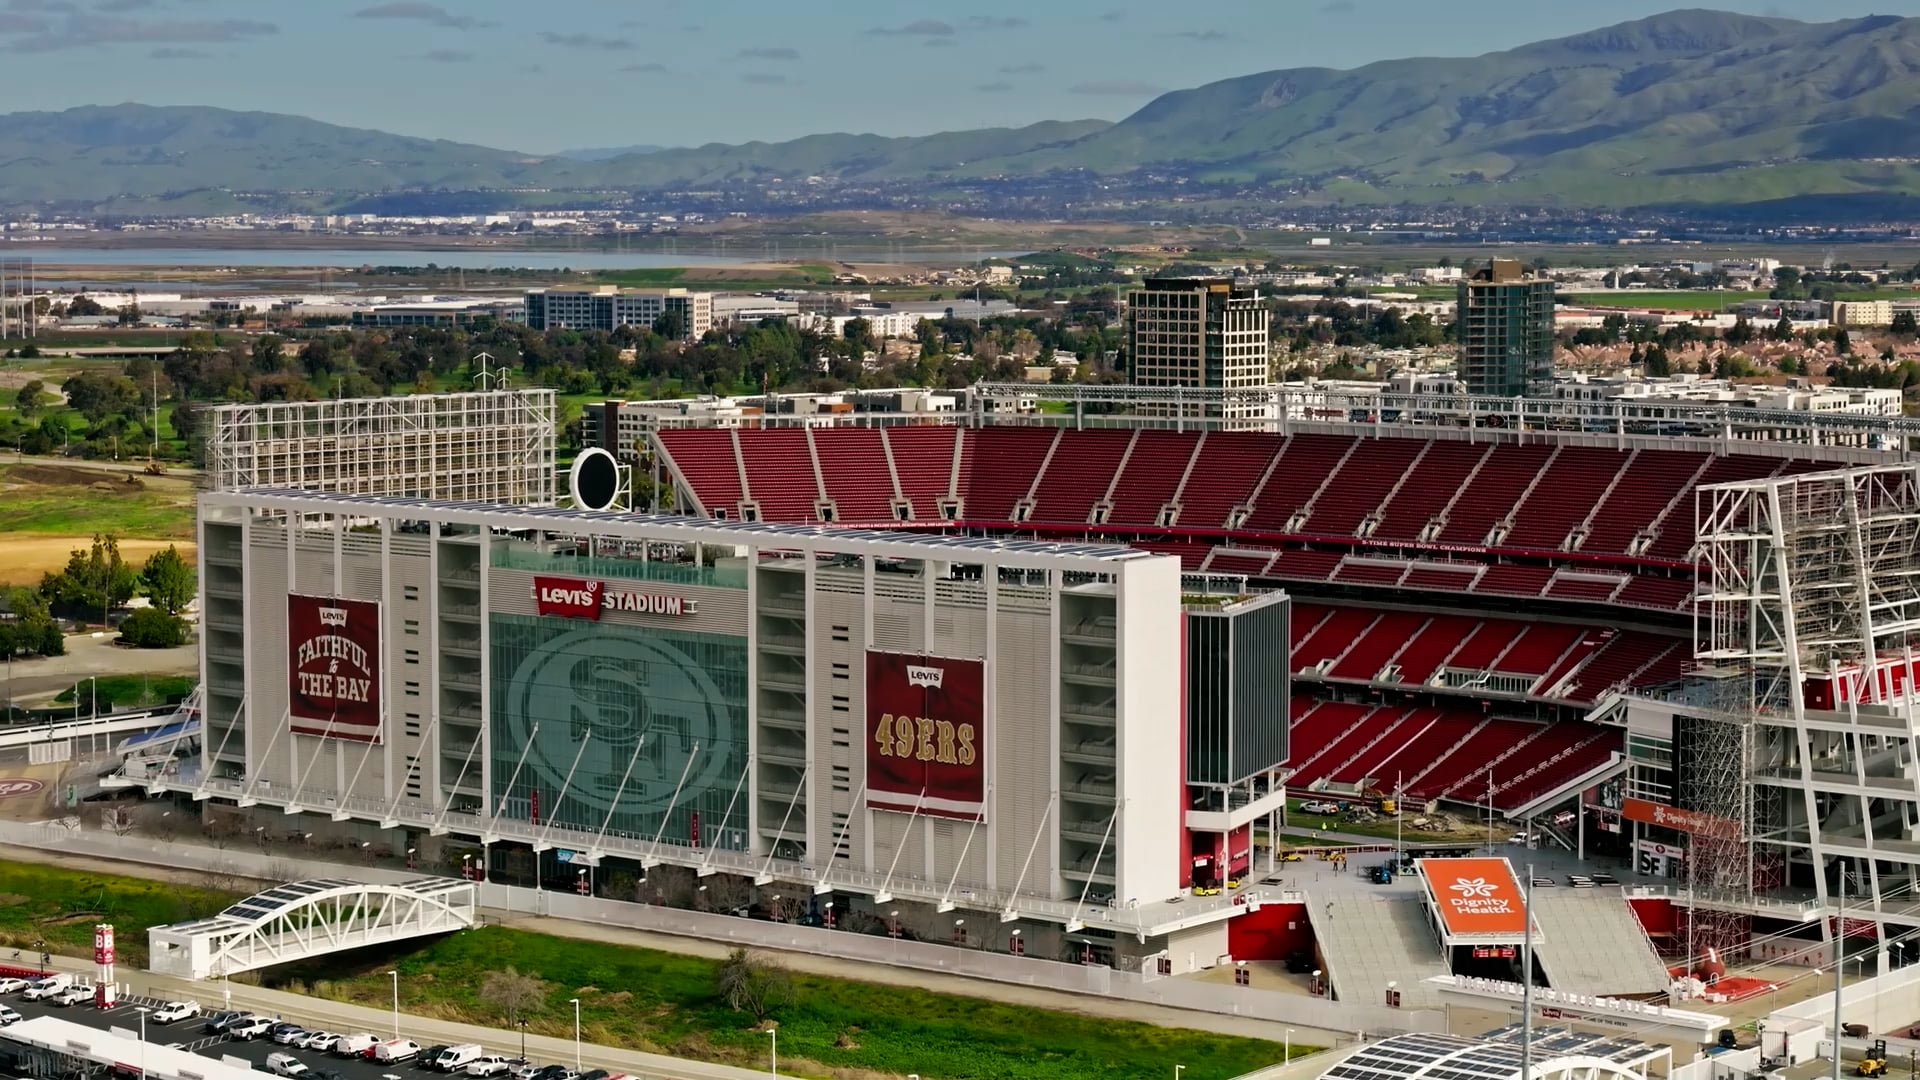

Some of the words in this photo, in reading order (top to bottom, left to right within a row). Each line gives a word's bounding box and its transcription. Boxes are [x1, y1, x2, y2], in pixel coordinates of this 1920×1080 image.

[1439, 545, 1487, 553] CHAMPIONS
[604, 591, 682, 615] STADIUM
[298, 634, 371, 677] FAITHFUL
[328, 658, 339, 674] to
[298, 671, 333, 698] THE
[336, 676, 371, 703] BAY
[875, 713, 976, 765] 49ERS
[1666, 812, 1687, 826] Dignity
[1450, 898, 1509, 908] Dignity
[96, 934, 103, 948] B
[104, 933, 113, 948] B
